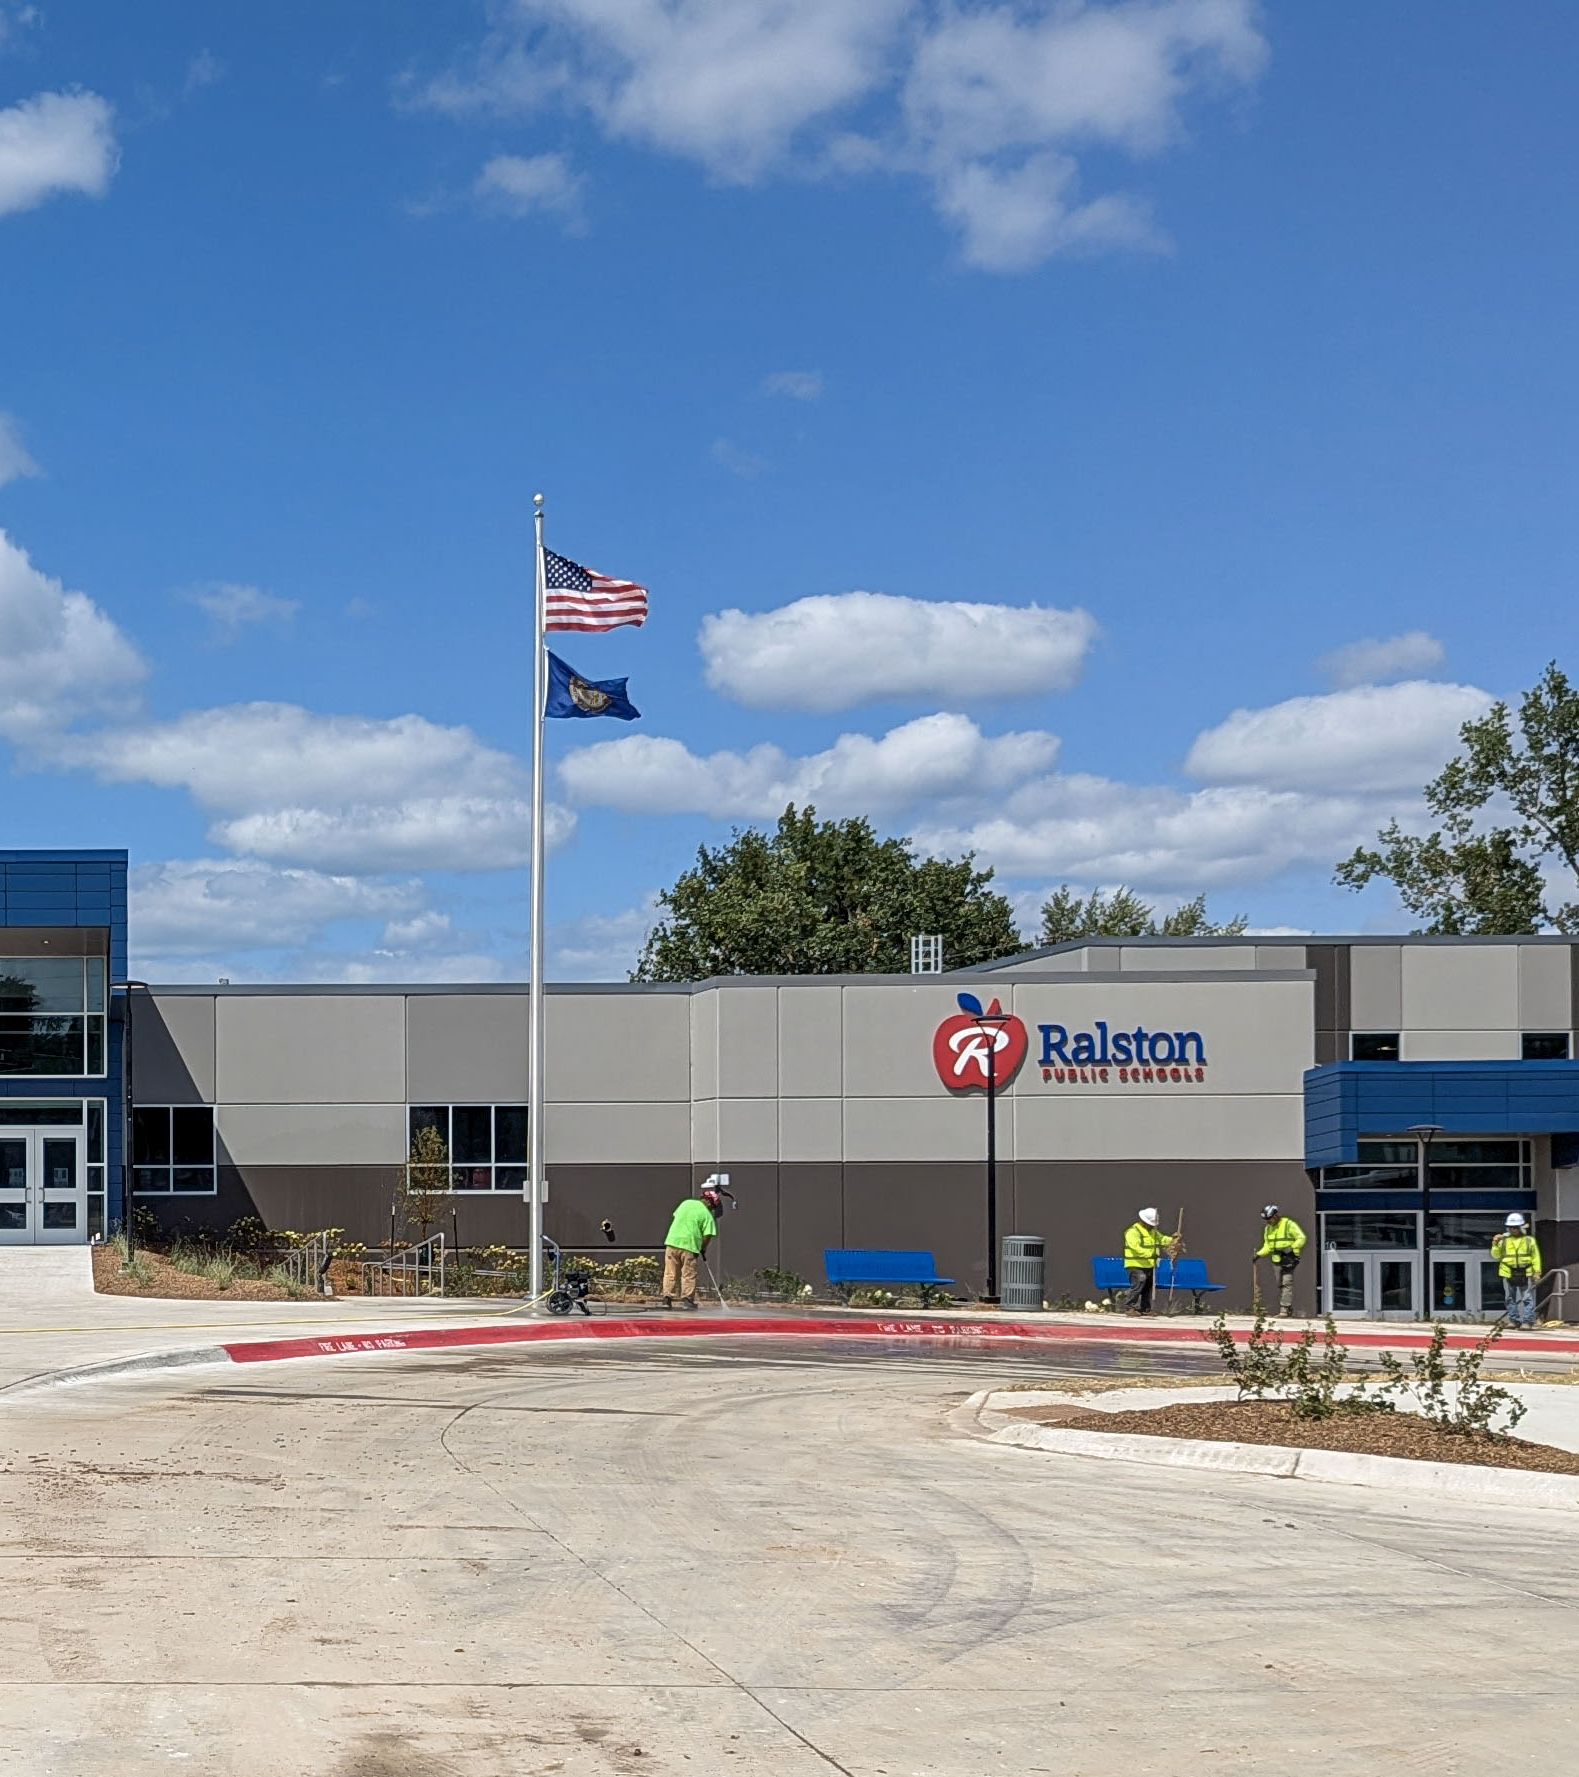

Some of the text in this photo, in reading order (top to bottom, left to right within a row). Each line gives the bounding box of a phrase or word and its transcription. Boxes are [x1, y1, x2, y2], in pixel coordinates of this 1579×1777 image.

[1038, 1021, 1206, 1065] Ralston
[1042, 1067, 1205, 1083] PUBLIC SCHOOLS
